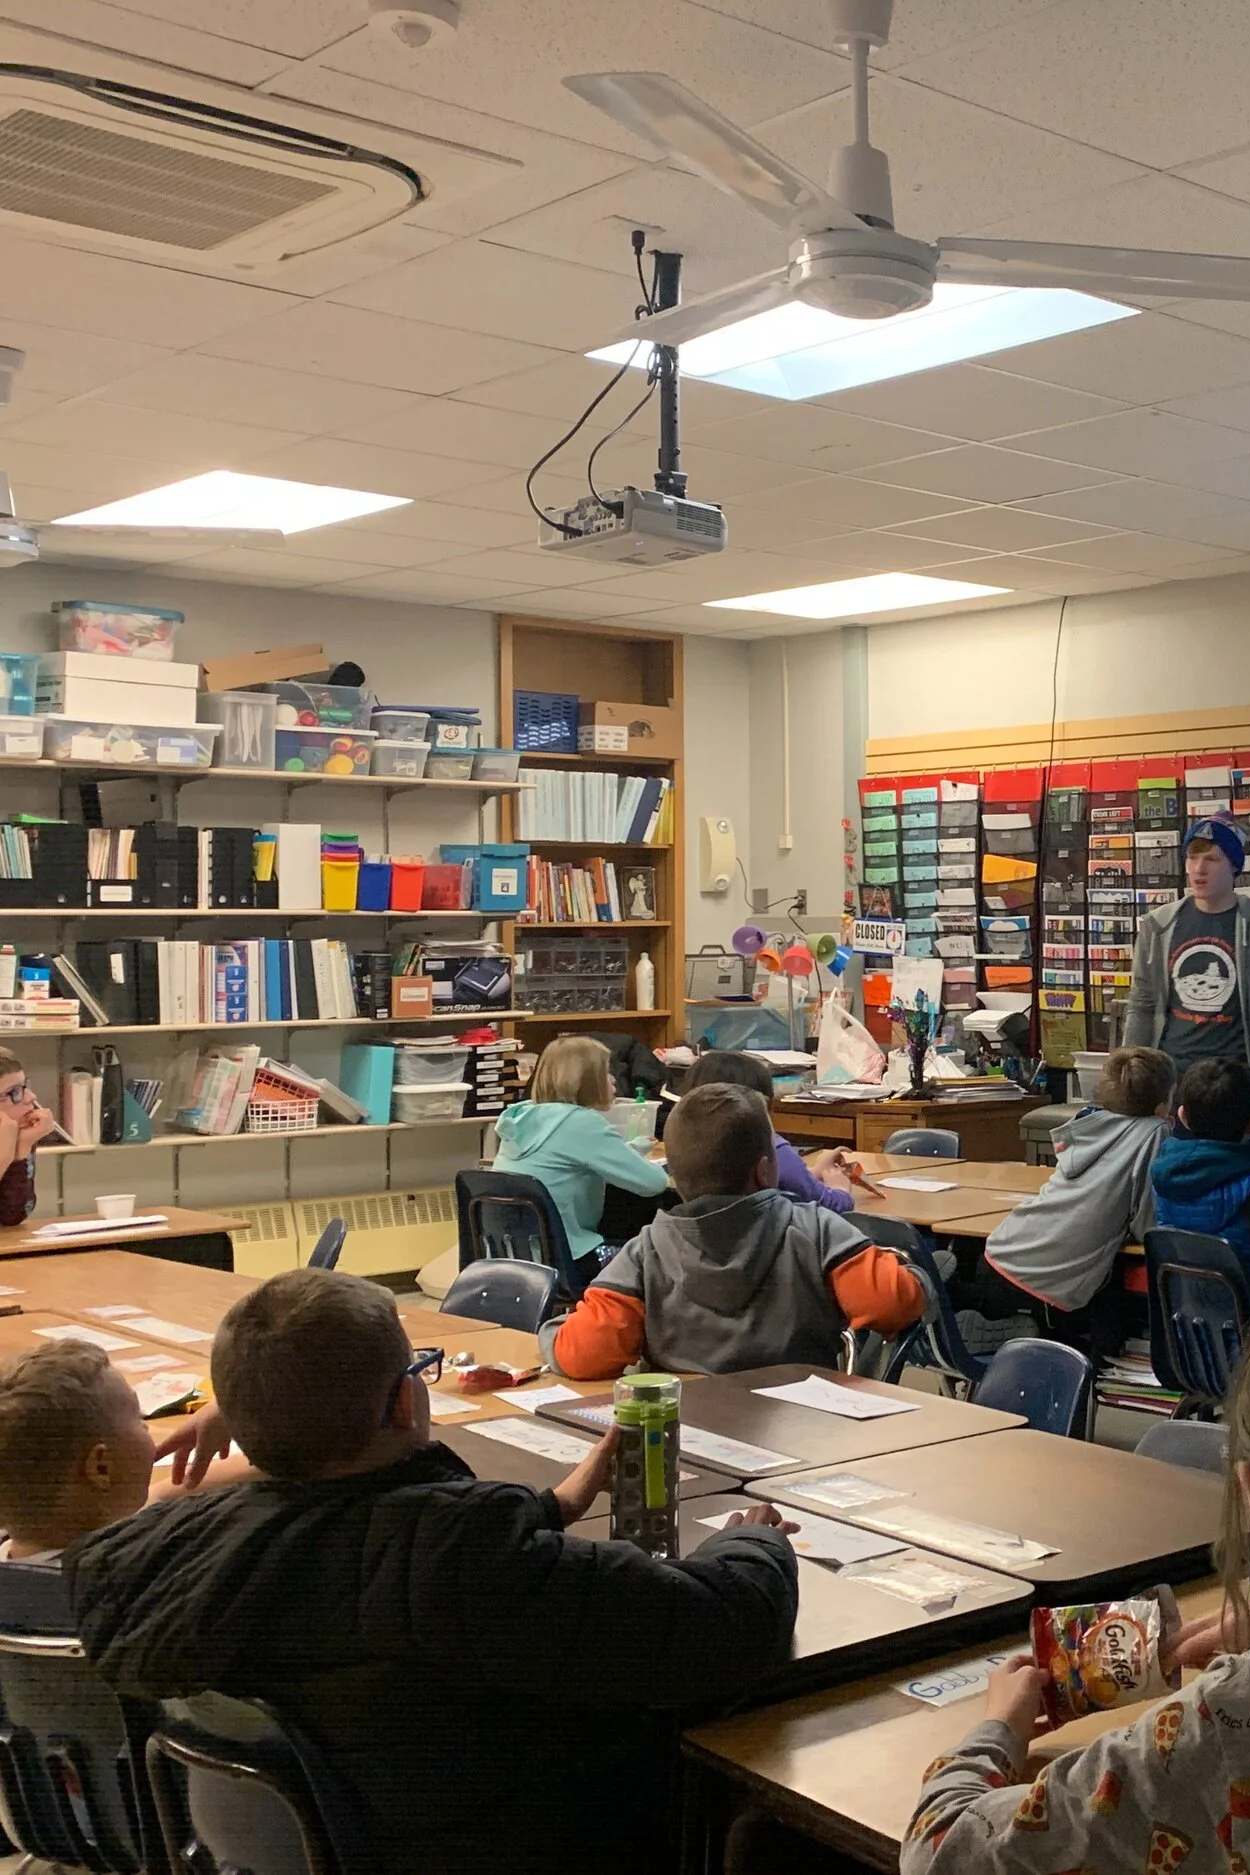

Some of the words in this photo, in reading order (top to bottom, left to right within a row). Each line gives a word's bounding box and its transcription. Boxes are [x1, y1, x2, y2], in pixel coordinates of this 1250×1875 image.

[1144, 804, 1161, 817] the
[855, 923, 885, 940] CLOSED
[432, 1003, 481, 1012] canSnap
[129, 1123, 139, 1137] 5
[1215, 1708, 1243, 1730] Fries
